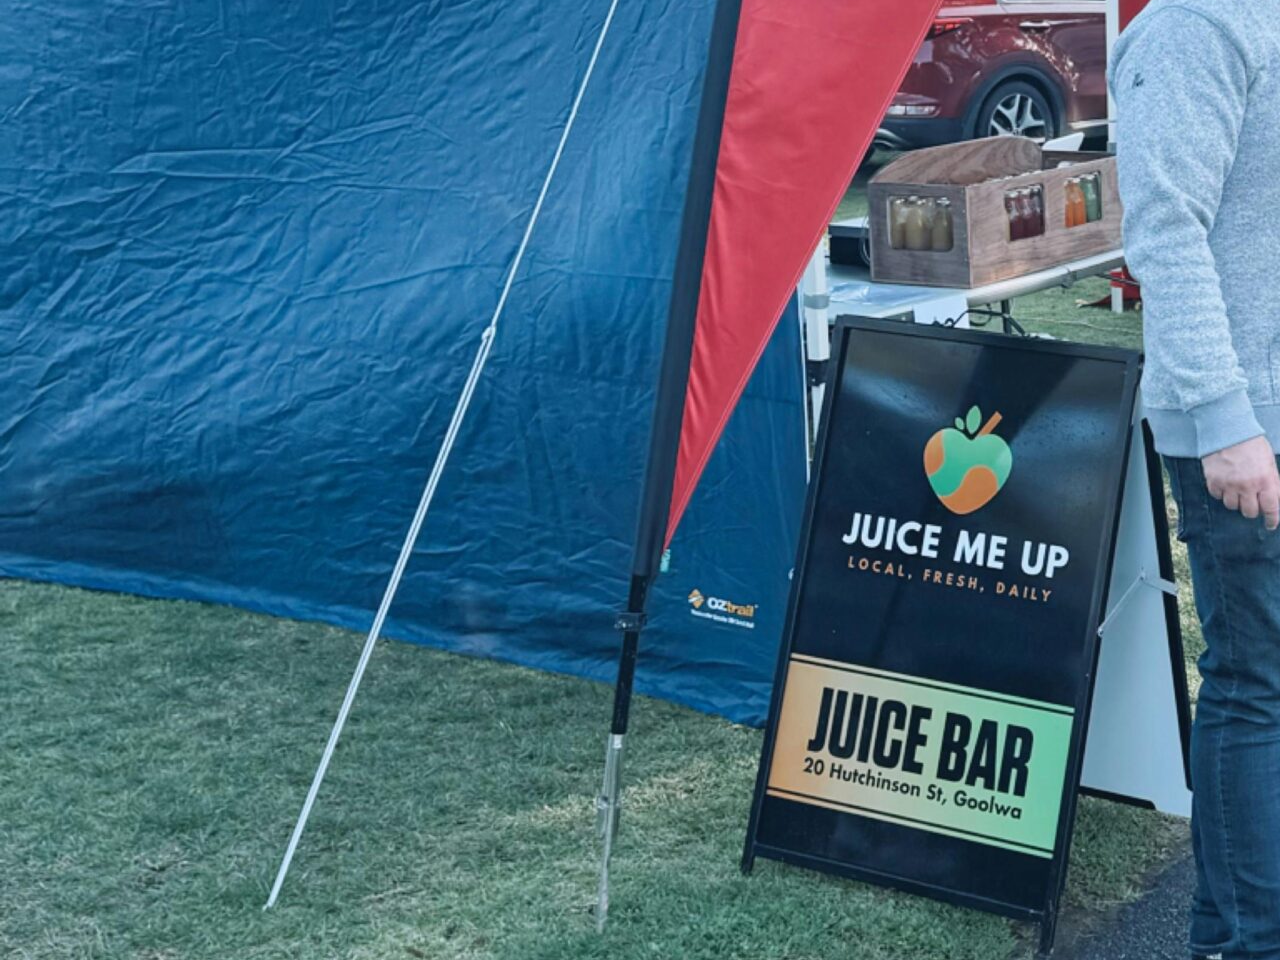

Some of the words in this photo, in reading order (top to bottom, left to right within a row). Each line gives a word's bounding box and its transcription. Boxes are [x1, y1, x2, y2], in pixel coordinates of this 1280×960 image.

[842, 512, 942, 558] JUICE
[953, 530, 1008, 570] ME
[1020, 540, 1070, 578] UP
[848, 555, 912, 580] LOCAL,
[923, 569, 984, 593] FRESH,
[996, 582, 1052, 602] DAILY
[807, 687, 933, 775] JUICE
[936, 711, 1034, 797] BAR
[803, 757, 825, 776] 20
[829, 763, 921, 798] Hutchinson
[926, 783, 947, 805] St,
[953, 790, 1022, 820] Goolwa
